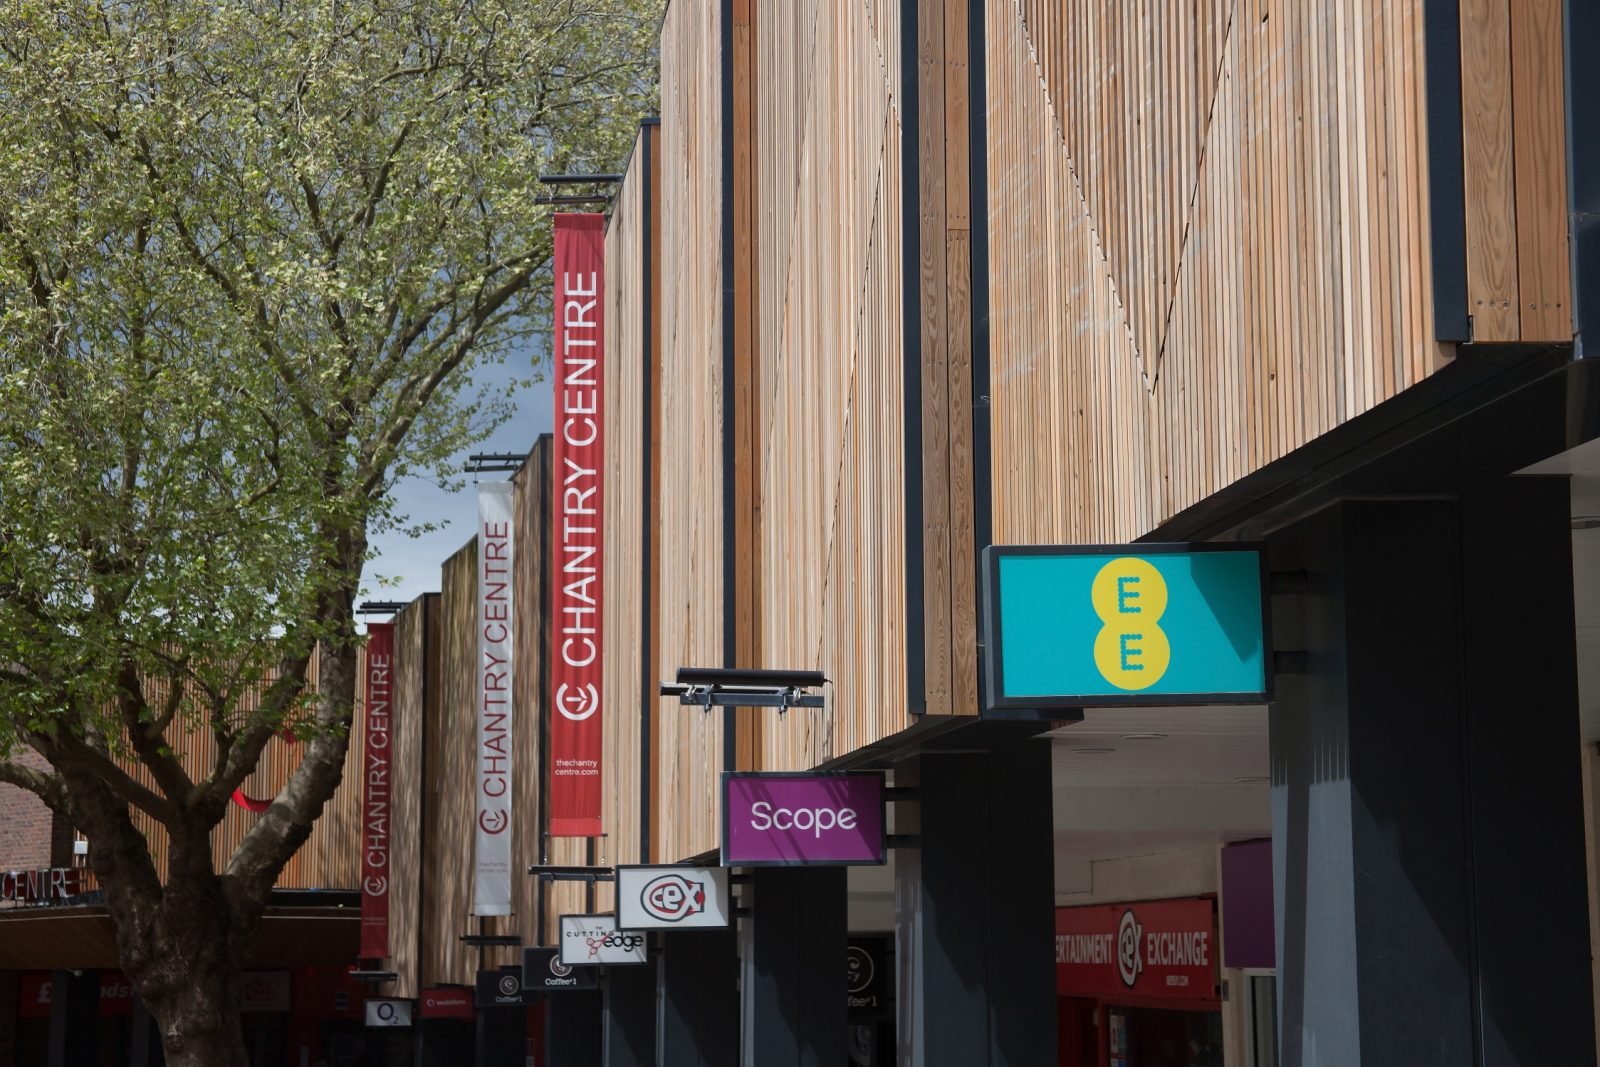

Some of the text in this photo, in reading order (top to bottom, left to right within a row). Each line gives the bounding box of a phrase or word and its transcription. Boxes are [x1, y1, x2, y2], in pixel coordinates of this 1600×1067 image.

[562, 272, 597, 667] CHANTRY CENTRE
[483, 521, 508, 797] CHANTRY CENTRE
[367, 653, 390, 868] CHANTRY CENTRE
[556, 758, 597, 768] thechantry
[750, 801, 857, 838] Scope
[1, 867, 74, 900] CENTRE
[604, 931, 643, 952] edge
[1056, 934, 1113, 964] ERTAINMENT
[1147, 932, 1208, 966] EXCHANGE
